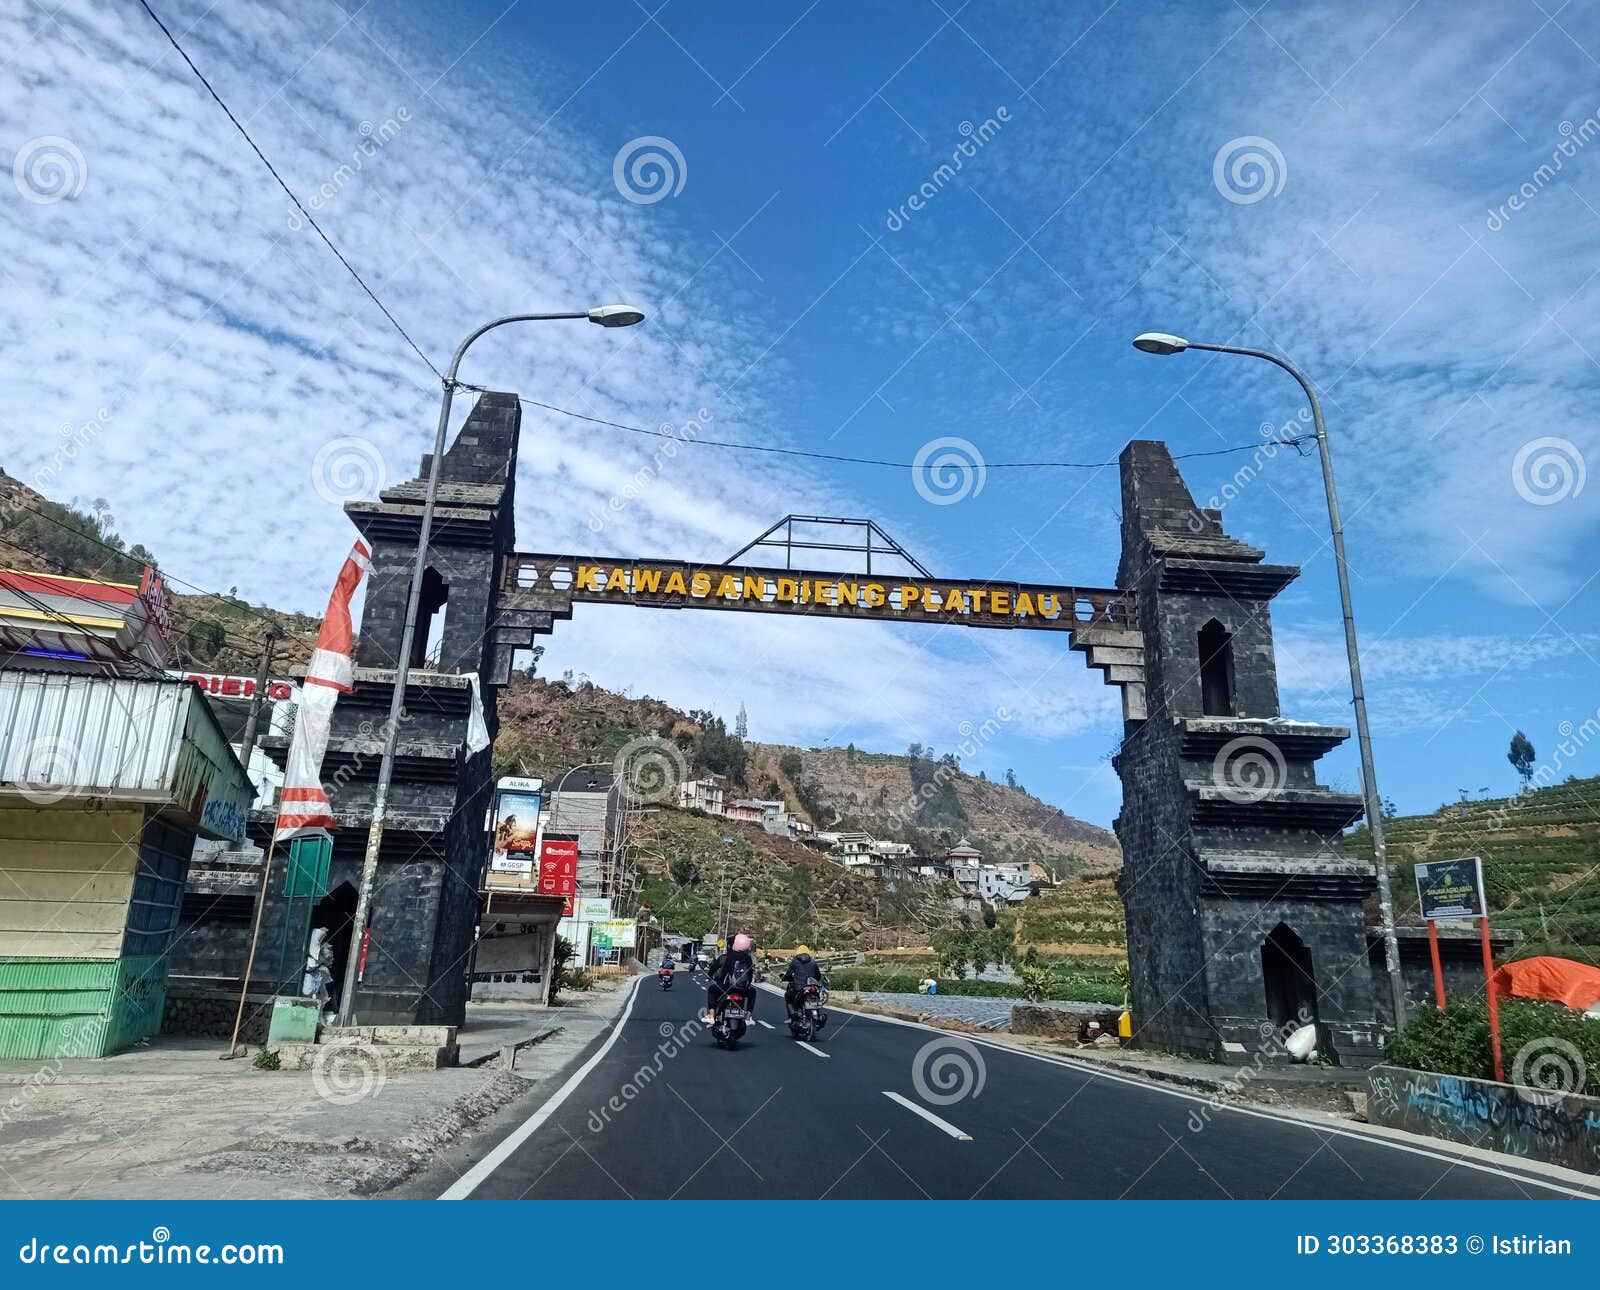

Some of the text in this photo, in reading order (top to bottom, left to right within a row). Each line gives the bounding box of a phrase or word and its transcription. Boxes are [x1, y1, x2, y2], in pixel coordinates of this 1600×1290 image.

[576, 565, 1059, 616] KAWASAN DIENG PLATEAU
[508, 780, 530, 788] ALIKA
